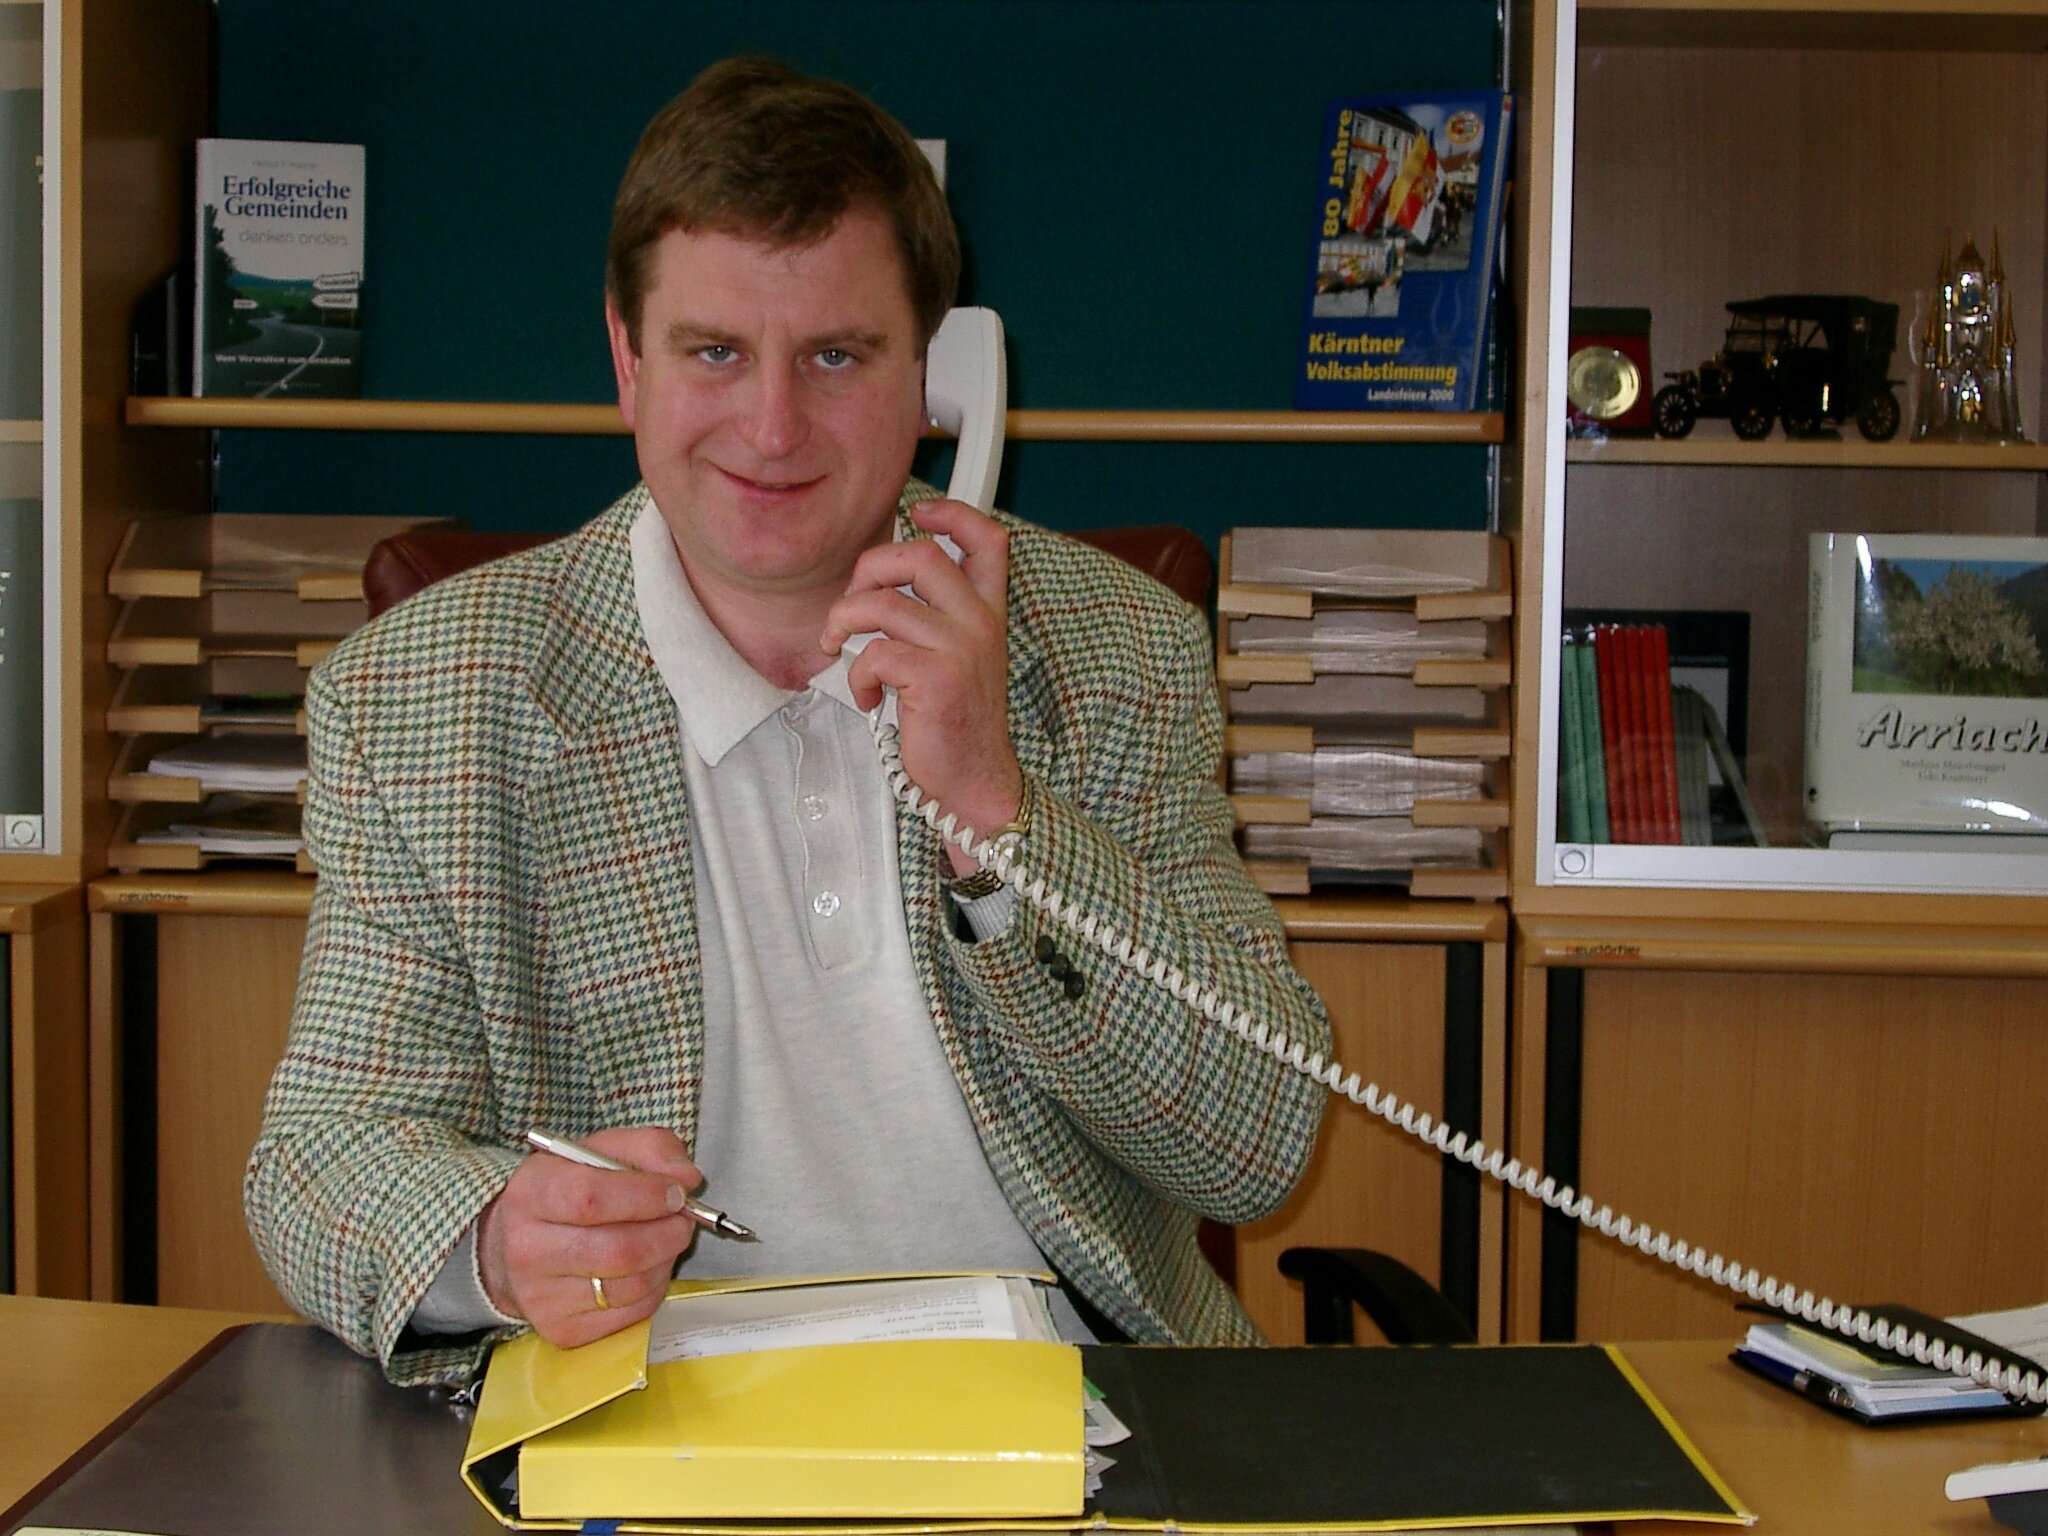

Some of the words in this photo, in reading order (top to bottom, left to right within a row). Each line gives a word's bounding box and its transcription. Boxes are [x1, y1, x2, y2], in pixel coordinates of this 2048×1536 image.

[1329, 109, 1352, 189] Jahre
[223, 174, 352, 201] Erfolgreiche
[224, 196, 348, 221] Gemeinden
[1323, 197, 1341, 238] 80
[239, 229, 295, 243] denken
[298, 232, 349, 246] anders
[1308, 331, 1405, 354] Kärntner
[1306, 359, 1458, 386] Volksabstimmung
[1859, 703, 2048, 754] Arriach
